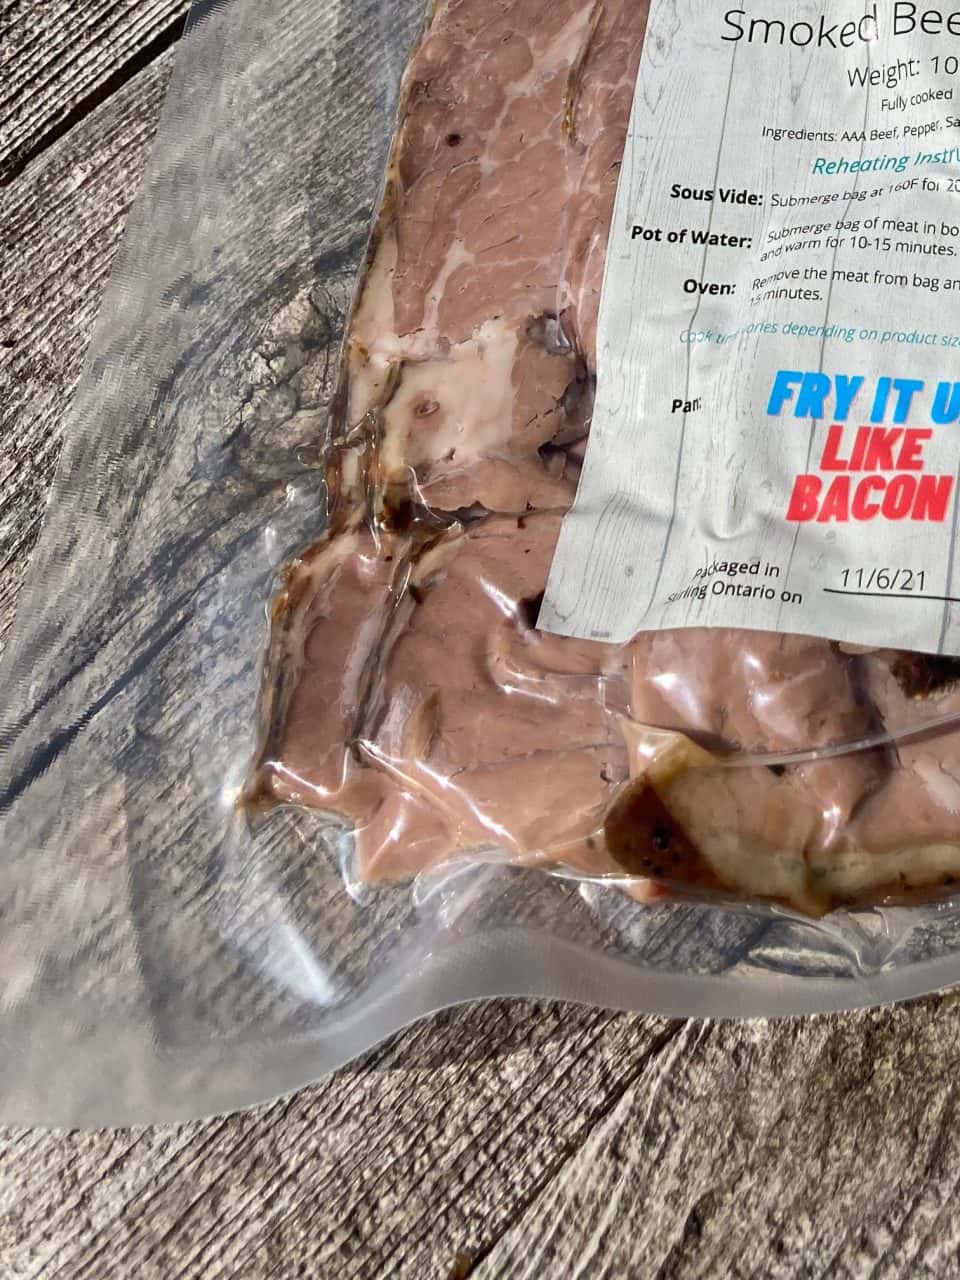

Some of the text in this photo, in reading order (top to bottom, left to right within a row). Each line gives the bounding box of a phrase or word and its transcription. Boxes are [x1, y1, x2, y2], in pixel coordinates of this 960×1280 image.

[720, 3, 880, 49] Smoked
[847, 57, 921, 89] Weight:
[930, 56, 958, 74] 10
[881, 88, 953, 112] Fully cooked
[762, 125, 837, 143] Ingredients:
[840, 130, 866, 142] AAA
[870, 128, 900, 141] Beef,
[812, 154, 908, 175] Reheating
[670, 183, 763, 206] Sous Vide:
[770, 193, 839, 207] Submerge
[842, 189, 867, 202] bag
[870, 189, 883, 198] at
[631, 226, 752, 248] Pot of Water:
[766, 223, 831, 243] Submerge
[835, 218, 860, 232] bag
[863, 217, 880, 229] of
[882, 219, 919, 234] meat
[923, 221, 936, 234] in
[760, 236, 957, 262] and warm for 10-15 minutes.
[683, 279, 736, 296] Oven:
[752, 268, 800, 291] Remove
[804, 267, 827, 280] the
[832, 270, 869, 284] meat
[874, 271, 908, 286] from
[913, 274, 939, 292] bag
[762, 287, 823, 301] minutes.
[680, 330, 713, 344] Cook
[782, 321, 855, 343] depending
[859, 329, 878, 341] on
[881, 329, 937, 347] product
[766, 370, 863, 422] FRY
[869, 377, 925, 424] IT
[820, 425, 932, 472] LIKE
[785, 475, 954, 523] BACON
[765, 562, 780, 577] in
[712, 580, 775, 600] Ontario
[781, 591, 803, 604] on
[841, 567, 927, 593] 11/6/21
